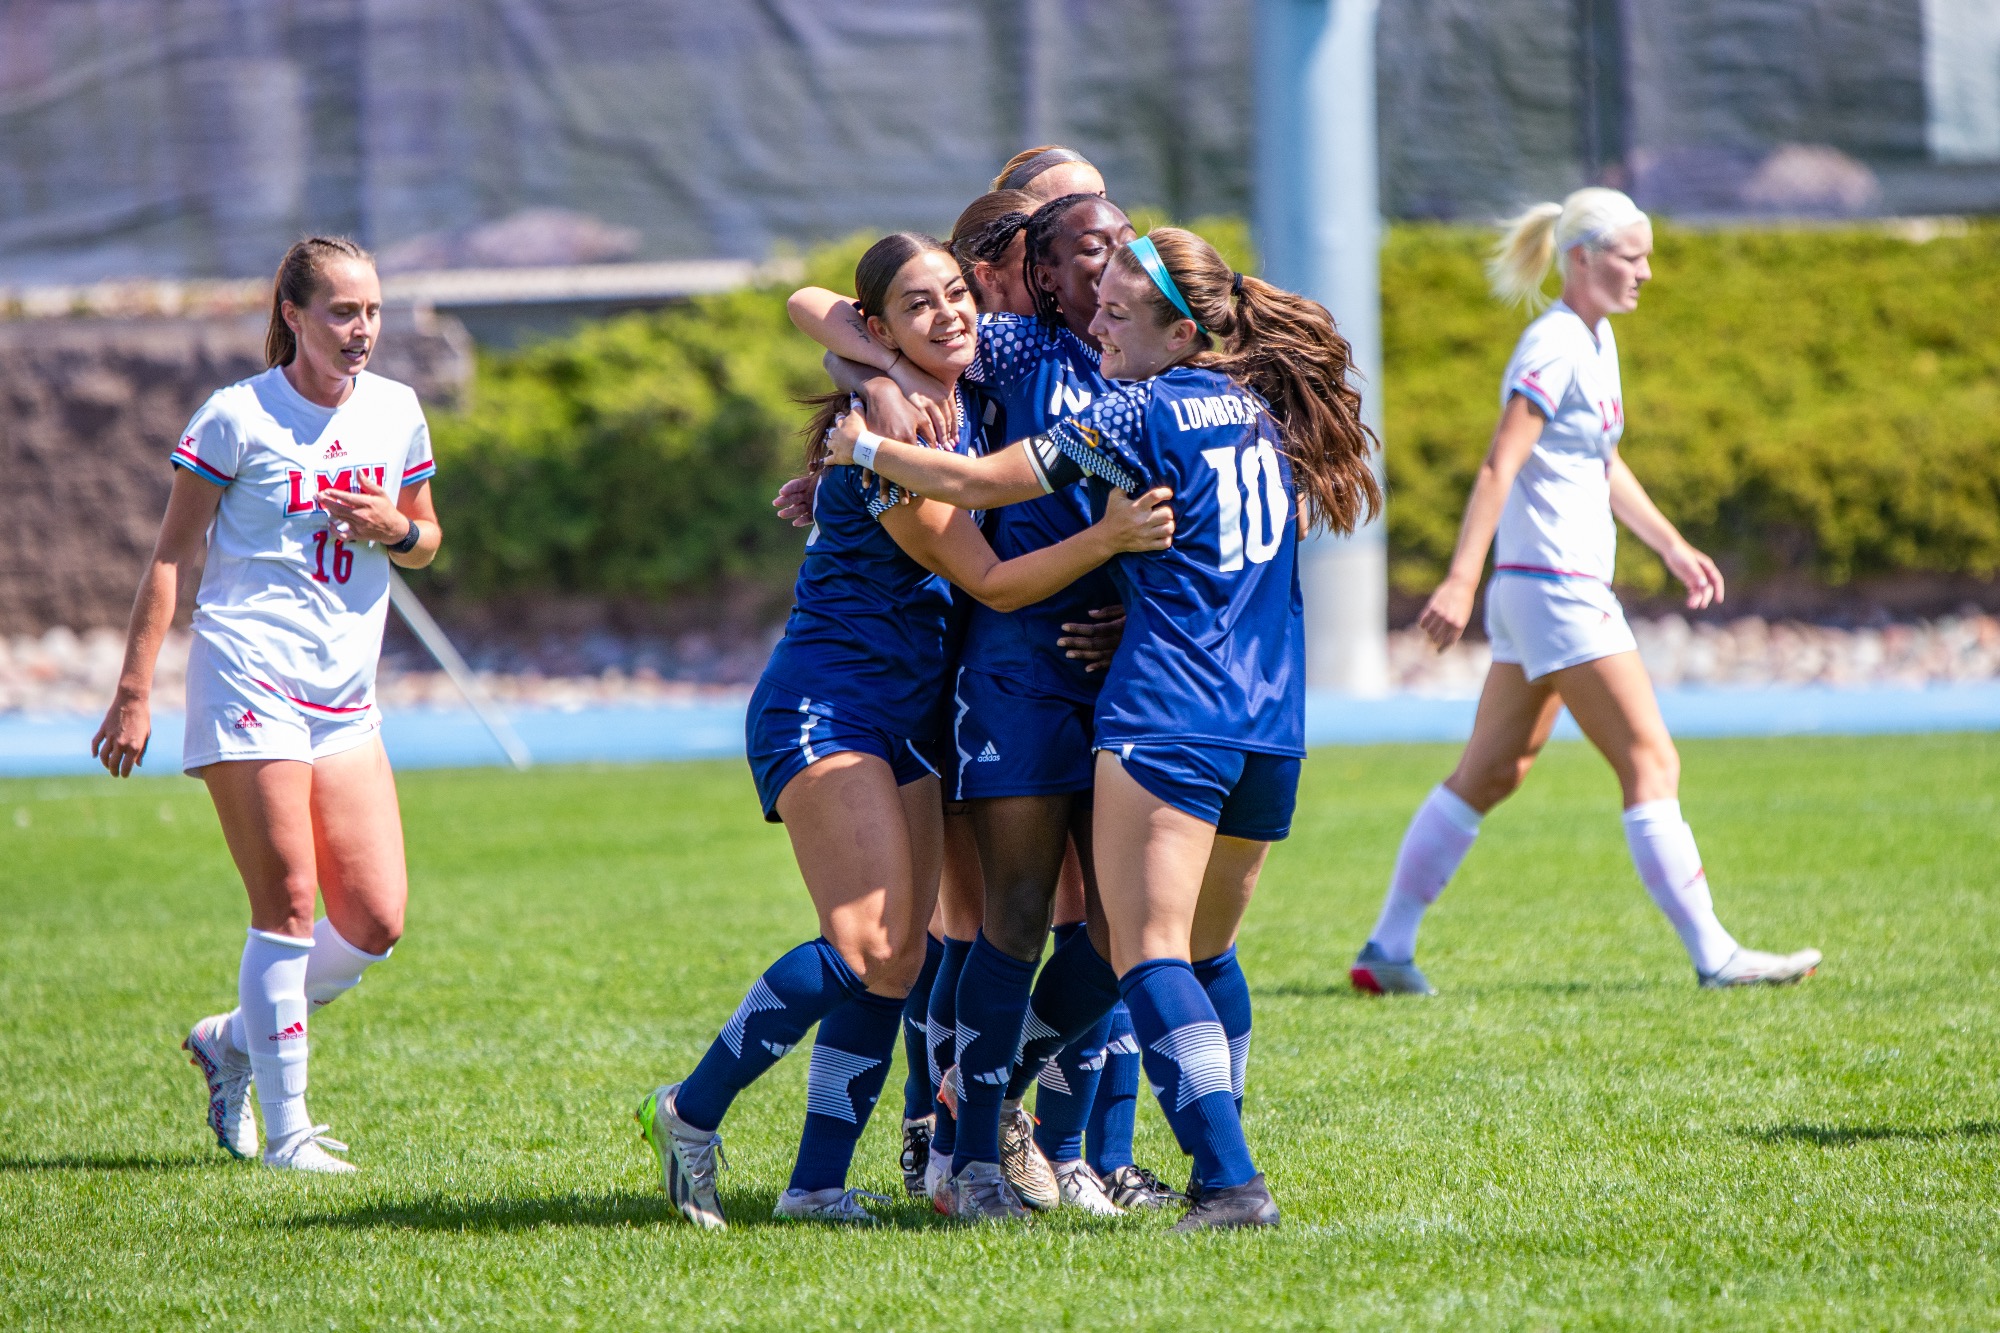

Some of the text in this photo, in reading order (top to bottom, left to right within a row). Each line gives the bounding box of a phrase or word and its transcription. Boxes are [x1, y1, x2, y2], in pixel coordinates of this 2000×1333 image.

[1170, 395, 1264, 431] LUMBER
[323, 451, 348, 460] adidas
[1200, 437, 1289, 573] 10
[311, 530, 354, 585] 16
[234, 721, 262, 729] adidas
[977, 754, 1001, 763] adidas
